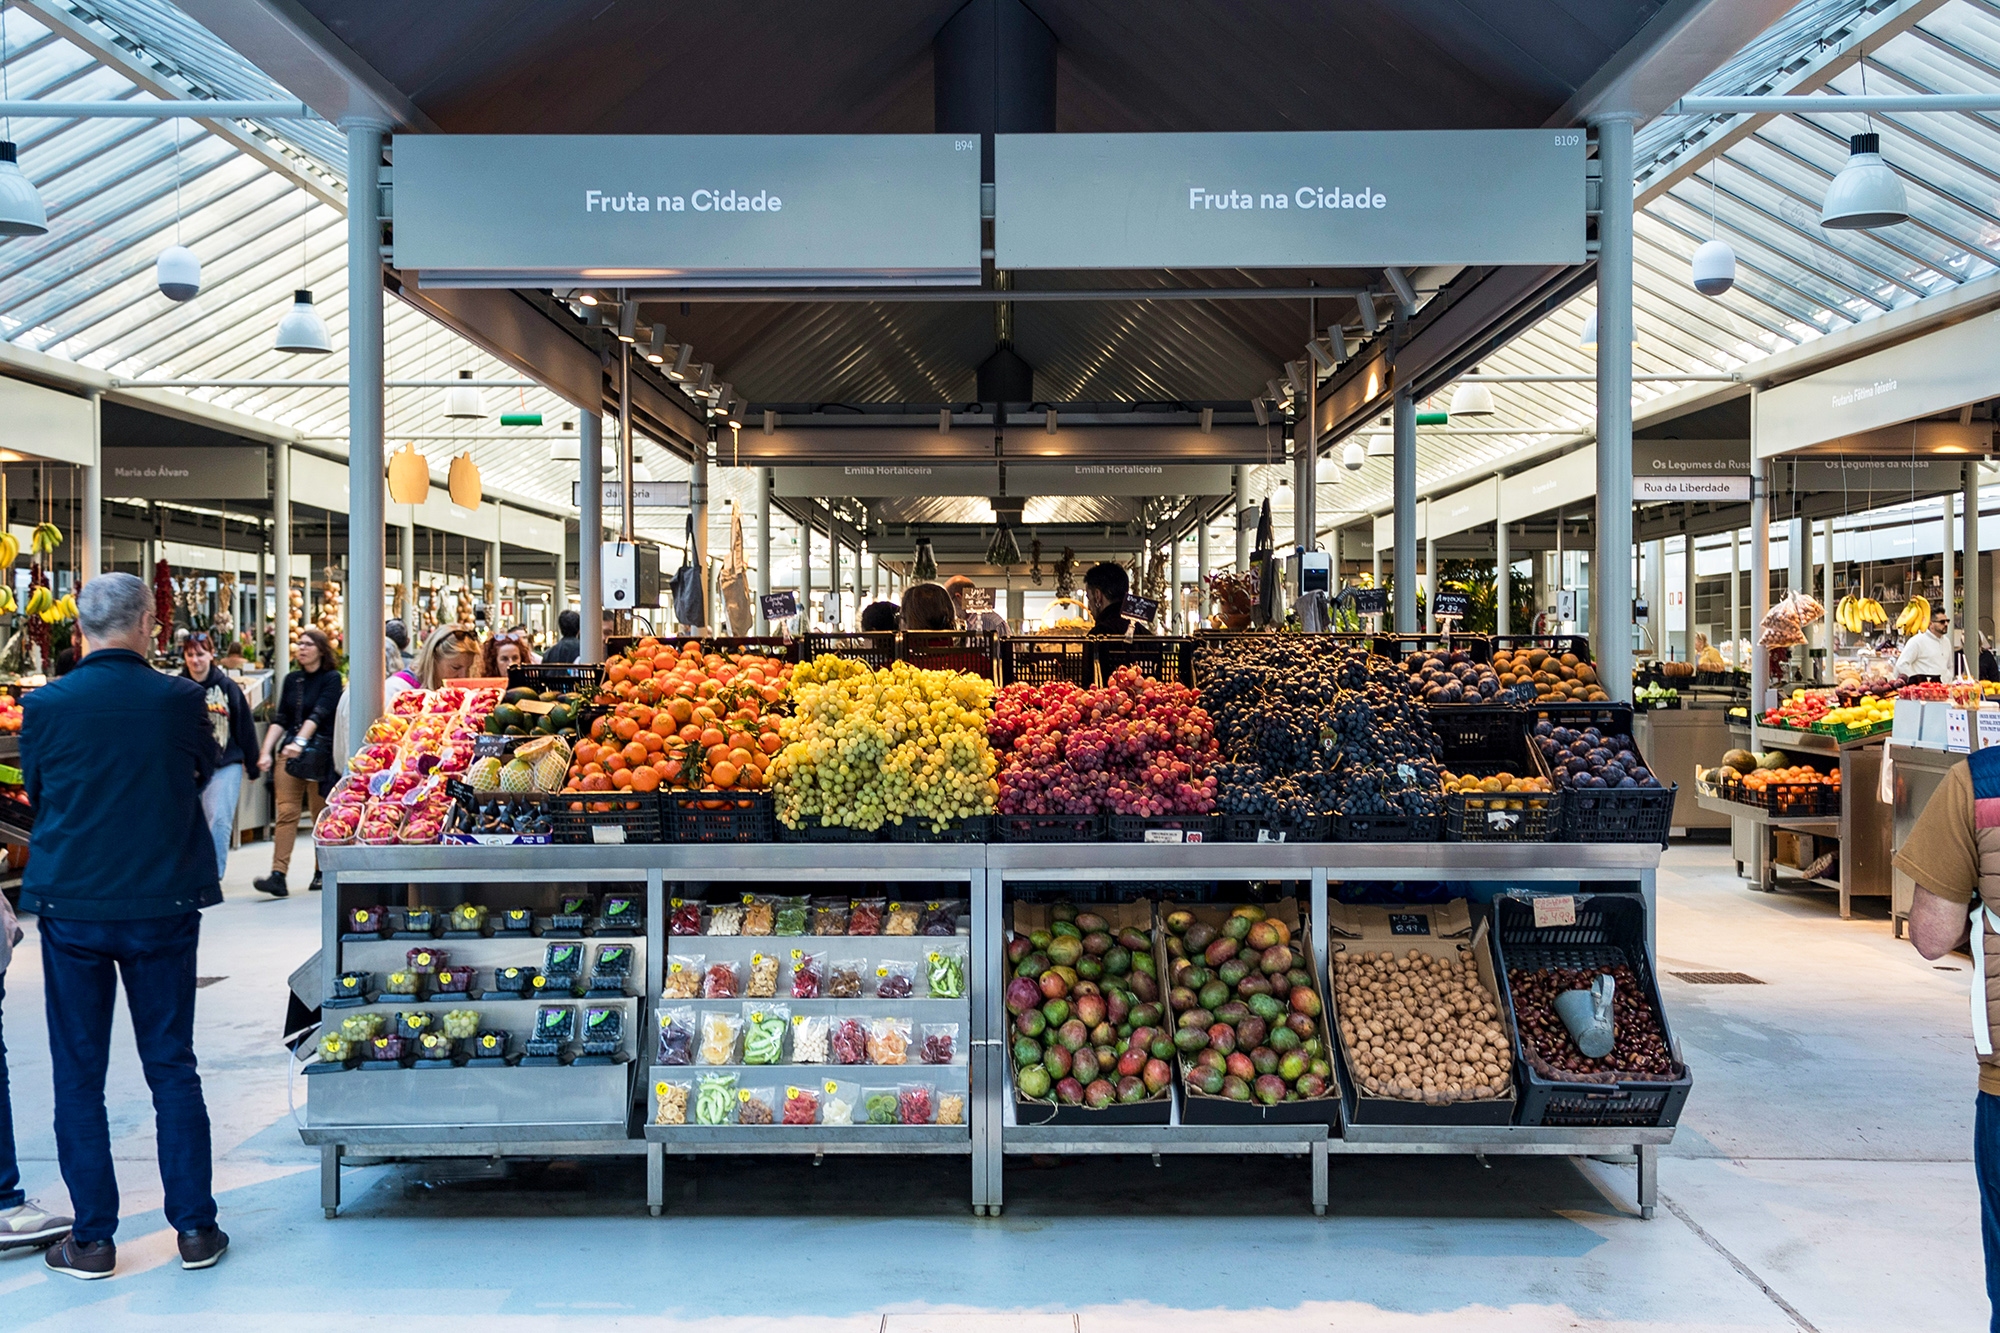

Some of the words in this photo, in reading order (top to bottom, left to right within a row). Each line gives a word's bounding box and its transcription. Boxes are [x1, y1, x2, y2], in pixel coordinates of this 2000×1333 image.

[954, 140, 974, 151] B94
[1554, 135, 1580, 146] B109
[586, 190, 650, 212] Fruta
[656, 196, 685, 212] na
[691, 189, 783, 212] Cidade
[1189, 187, 1254, 210] Fruta
[1260, 194, 1289, 209] na
[1295, 186, 1387, 209] Cidade
[1832, 391, 1854, 408] Frutaria
[1854, 387, 1874, 401] Fátima
[1874, 378, 1897, 395] Teixeira
[114, 467, 142, 477] Maria
[143, 467, 157, 477] do
[158, 465, 189, 477] Álvaro
[876, 466, 932, 475] Hortaliceira
[1106, 465, 1163, 474] Hortaliceira
[1652, 460, 1666, 469] Os
[1668, 460, 1713, 471] Legumes
[1714, 460, 1726, 469] da
[1728, 460, 1751, 469] Russ
[1825, 461, 1839, 469] Os
[1841, 461, 1885, 470] Legumes
[1901, 461, 1929, 469] Russa
[1644, 483, 1662, 492] Rua
[1664, 483, 1677, 492] da
[1679, 483, 1730, 492] Liberdade
